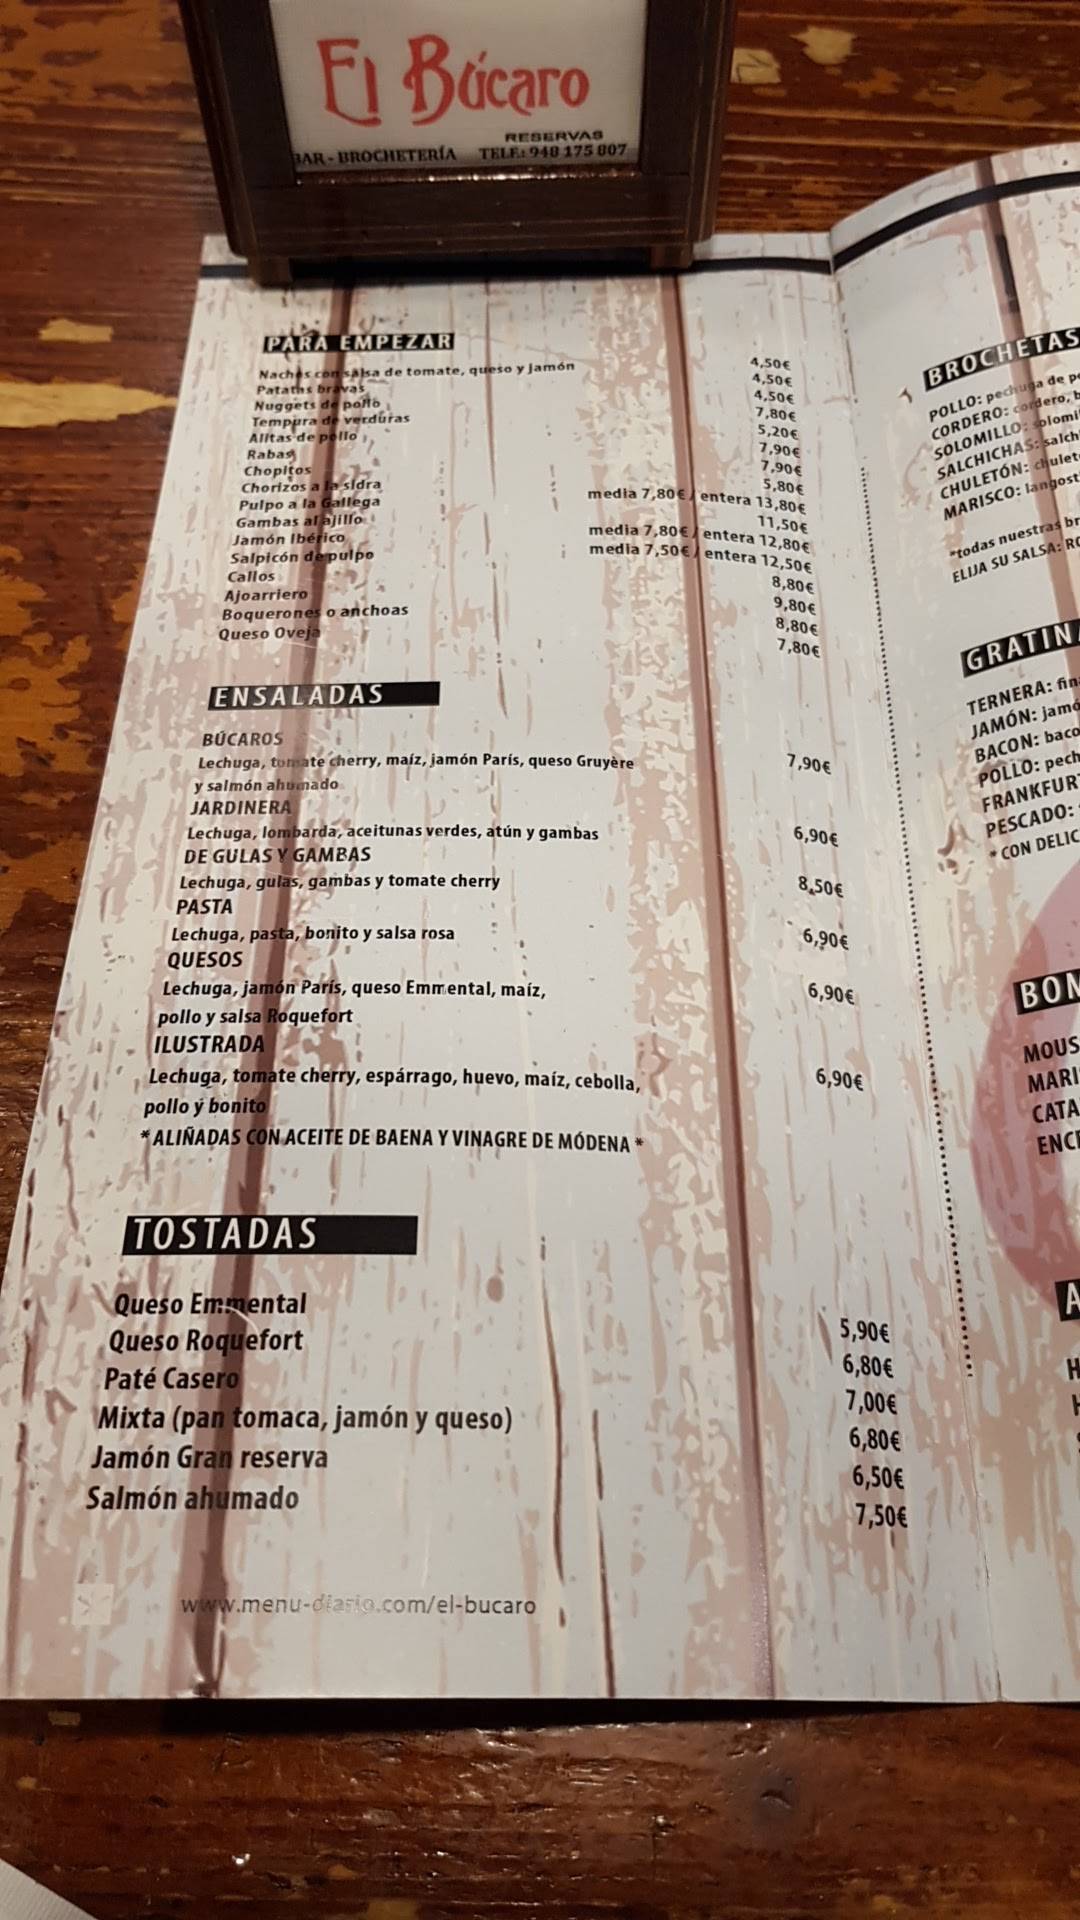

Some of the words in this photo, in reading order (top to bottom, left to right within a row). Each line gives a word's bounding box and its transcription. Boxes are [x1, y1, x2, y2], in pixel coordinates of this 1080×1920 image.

[317, 38, 381, 128] El
[404, 34, 590, 127] Búcaro
[505, 130, 603, 143] RESERVAS
[338, 147, 457, 163] BROCHETERÍA
[529, 144, 559, 158] 948
[564, 144, 594, 157] 175
[598, 143, 627, 156] 807
[267, 336, 328, 351] PARA
[340, 335, 452, 350] EMPEZAR
[750, 357, 791, 371] 4,50€
[928, 328, 1080, 387] BROCHETAS
[343, 368, 380, 378] salsa
[407, 365, 465, 376] tomate,
[469, 364, 512, 376] queso
[752, 373, 792, 387] 4,50€
[254, 400, 316, 412] Nuggets
[754, 390, 794, 405] 4,50€
[755, 407, 797, 422] 7,80€
[929, 395, 983, 422] POLLO:
[758, 424, 799, 440] 5,20€
[932, 407, 1009, 441] CORDERO:
[247, 449, 292, 459] Rabas
[759, 442, 801, 458] 7,90€
[937, 438, 1040, 480] SALCHICHAS:
[761, 460, 803, 477] 7,90€
[241, 481, 307, 493] Chorizos
[342, 479, 381, 490] sidra
[763, 479, 805, 495] 5,80€
[940, 462, 1029, 500] CHULETÓN:
[239, 499, 284, 513] Pulpo
[320, 497, 380, 510] Gallega
[588, 488, 637, 500] media
[641, 488, 685, 501] 7,80€
[700, 492, 751, 507] entera
[756, 496, 806, 514] 13,80€
[944, 486, 1021, 521] MARISCO:
[236, 516, 299, 528] Gambas
[322, 514, 363, 528] ajillo
[758, 516, 808, 534] 11,50€
[232, 533, 285, 547] Jamón
[290, 532, 345, 545] Ibérico
[589, 525, 639, 536] media
[643, 525, 688, 538] 7,80€
[703, 529, 755, 545] entera
[759, 535, 810, 553] 12,80€
[230, 550, 299, 566] Salpicón
[328, 549, 374, 564] pulpo
[589, 544, 640, 556] media
[644, 544, 689, 557] 7,50€
[705, 549, 756, 565] entera
[761, 555, 812, 574] 12,50€
[227, 570, 275, 583] Callos
[772, 576, 814, 594] 8,80€
[224, 588, 308, 602] Ajoarriero
[222, 607, 321, 622] Boquerones
[340, 604, 408, 618] anchoas
[774, 596, 816, 615] 9,80€
[218, 627, 269, 642] Queso
[776, 617, 818, 636] 8,80€
[777, 638, 820, 658] 7,80€
[214, 684, 383, 707] ENSALADAS
[967, 681, 1052, 716] TERNERA:
[971, 709, 1037, 740] JAMÓN:
[202, 731, 283, 747] BÚCAROS
[974, 733, 1039, 764] BACON:
[198, 757, 265, 771] Lechuga,
[329, 754, 381, 768] cherry,
[386, 753, 427, 767] maíz,
[430, 754, 477, 768] jamón
[483, 754, 524, 767] París,
[528, 757, 572, 770] queso
[577, 756, 634, 771] Gruyère
[787, 753, 831, 775] 7,90€
[978, 759, 1039, 788] POLLO:
[208, 780, 262, 792] salmón
[190, 800, 291, 816] JARDINERA
[986, 804, 1074, 838] PESCADO:
[187, 827, 257, 841] Lechuga,
[262, 826, 342, 839] lombarda,
[347, 824, 422, 837] aceitunas
[426, 825, 482, 839] verdes,
[486, 826, 521, 838] atún
[539, 827, 599, 842] gambas
[793, 826, 839, 847] 6,90€
[213, 849, 272, 863] GULAS
[293, 847, 371, 862] GAMBAS
[180, 876, 251, 890] Lechuga,
[256, 875, 303, 890] gulas,
[308, 874, 370, 889] gambas
[389, 875, 446, 887] tomate
[451, 875, 500, 890] cherry
[176, 899, 233, 915] PASTA
[171, 928, 244, 943] Lechuga,
[305, 926, 359, 940] bonito
[376, 926, 415, 939] salsa
[422, 929, 454, 940] rosa
[802, 928, 849, 950] 6,90€
[168, 952, 243, 969] QUESOS
[163, 982, 238, 998] Lechuga,
[242, 980, 295, 997] jamón
[302, 980, 346, 996] París,
[352, 982, 401, 996] queso
[501, 982, 546, 999] maíz,
[808, 983, 855, 1005] 6,90€
[157, 1009, 201, 1027] pollo
[220, 1010, 261, 1023] salsa
[268, 1009, 353, 1025] Roquefort
[154, 1035, 265, 1053] ILUSTRADA
[149, 1069, 228, 1087] Lechuga,
[233, 1069, 296, 1083] tomate
[300, 1068, 361, 1085] cherry,
[366, 1068, 457, 1087] espárrago,
[463, 1069, 519, 1087] huevo,
[525, 1071, 570, 1089] maíz,
[575, 1073, 641, 1093] cebolla,
[816, 1068, 864, 1091] 6,90€
[144, 1099, 189, 1118] pollo
[209, 1098, 266, 1114] bonito
[152, 1127, 241, 1146] ALIÑADAS
[285, 1129, 343, 1145] ACEITE
[376, 1129, 432, 1145] BAENA
[452, 1130, 527, 1147] VINAGRE
[558, 1132, 630, 1152] MÓDENA
[133, 1217, 318, 1250] TOSTADAS
[114, 1293, 183, 1317] Queso
[190, 1292, 307, 1314] Emmental
[840, 1318, 889, 1343] 5,90€
[109, 1330, 179, 1353] Queso
[186, 1329, 304, 1354] Roquefort
[843, 1354, 894, 1378] 6,80€
[104, 1368, 156, 1390] Paté
[162, 1367, 239, 1389] Casero
[846, 1389, 897, 1414] 7,00€
[98, 1406, 165, 1429] Mixta
[172, 1406, 224, 1434] (pan
[233, 1407, 328, 1431] tomaca,
[333, 1406, 408, 1434] jamón
[435, 1407, 512, 1434] queso)
[850, 1427, 901, 1452] 6,80€
[91, 1446, 170, 1470] Jamón
[177, 1446, 232, 1470] Gran
[240, 1450, 328, 1469] reserva
[853, 1465, 904, 1490] 6,50€
[86, 1486, 177, 1510] Salmón
[184, 1486, 299, 1510] ahumado
[855, 1503, 908, 1529] 7,50€
